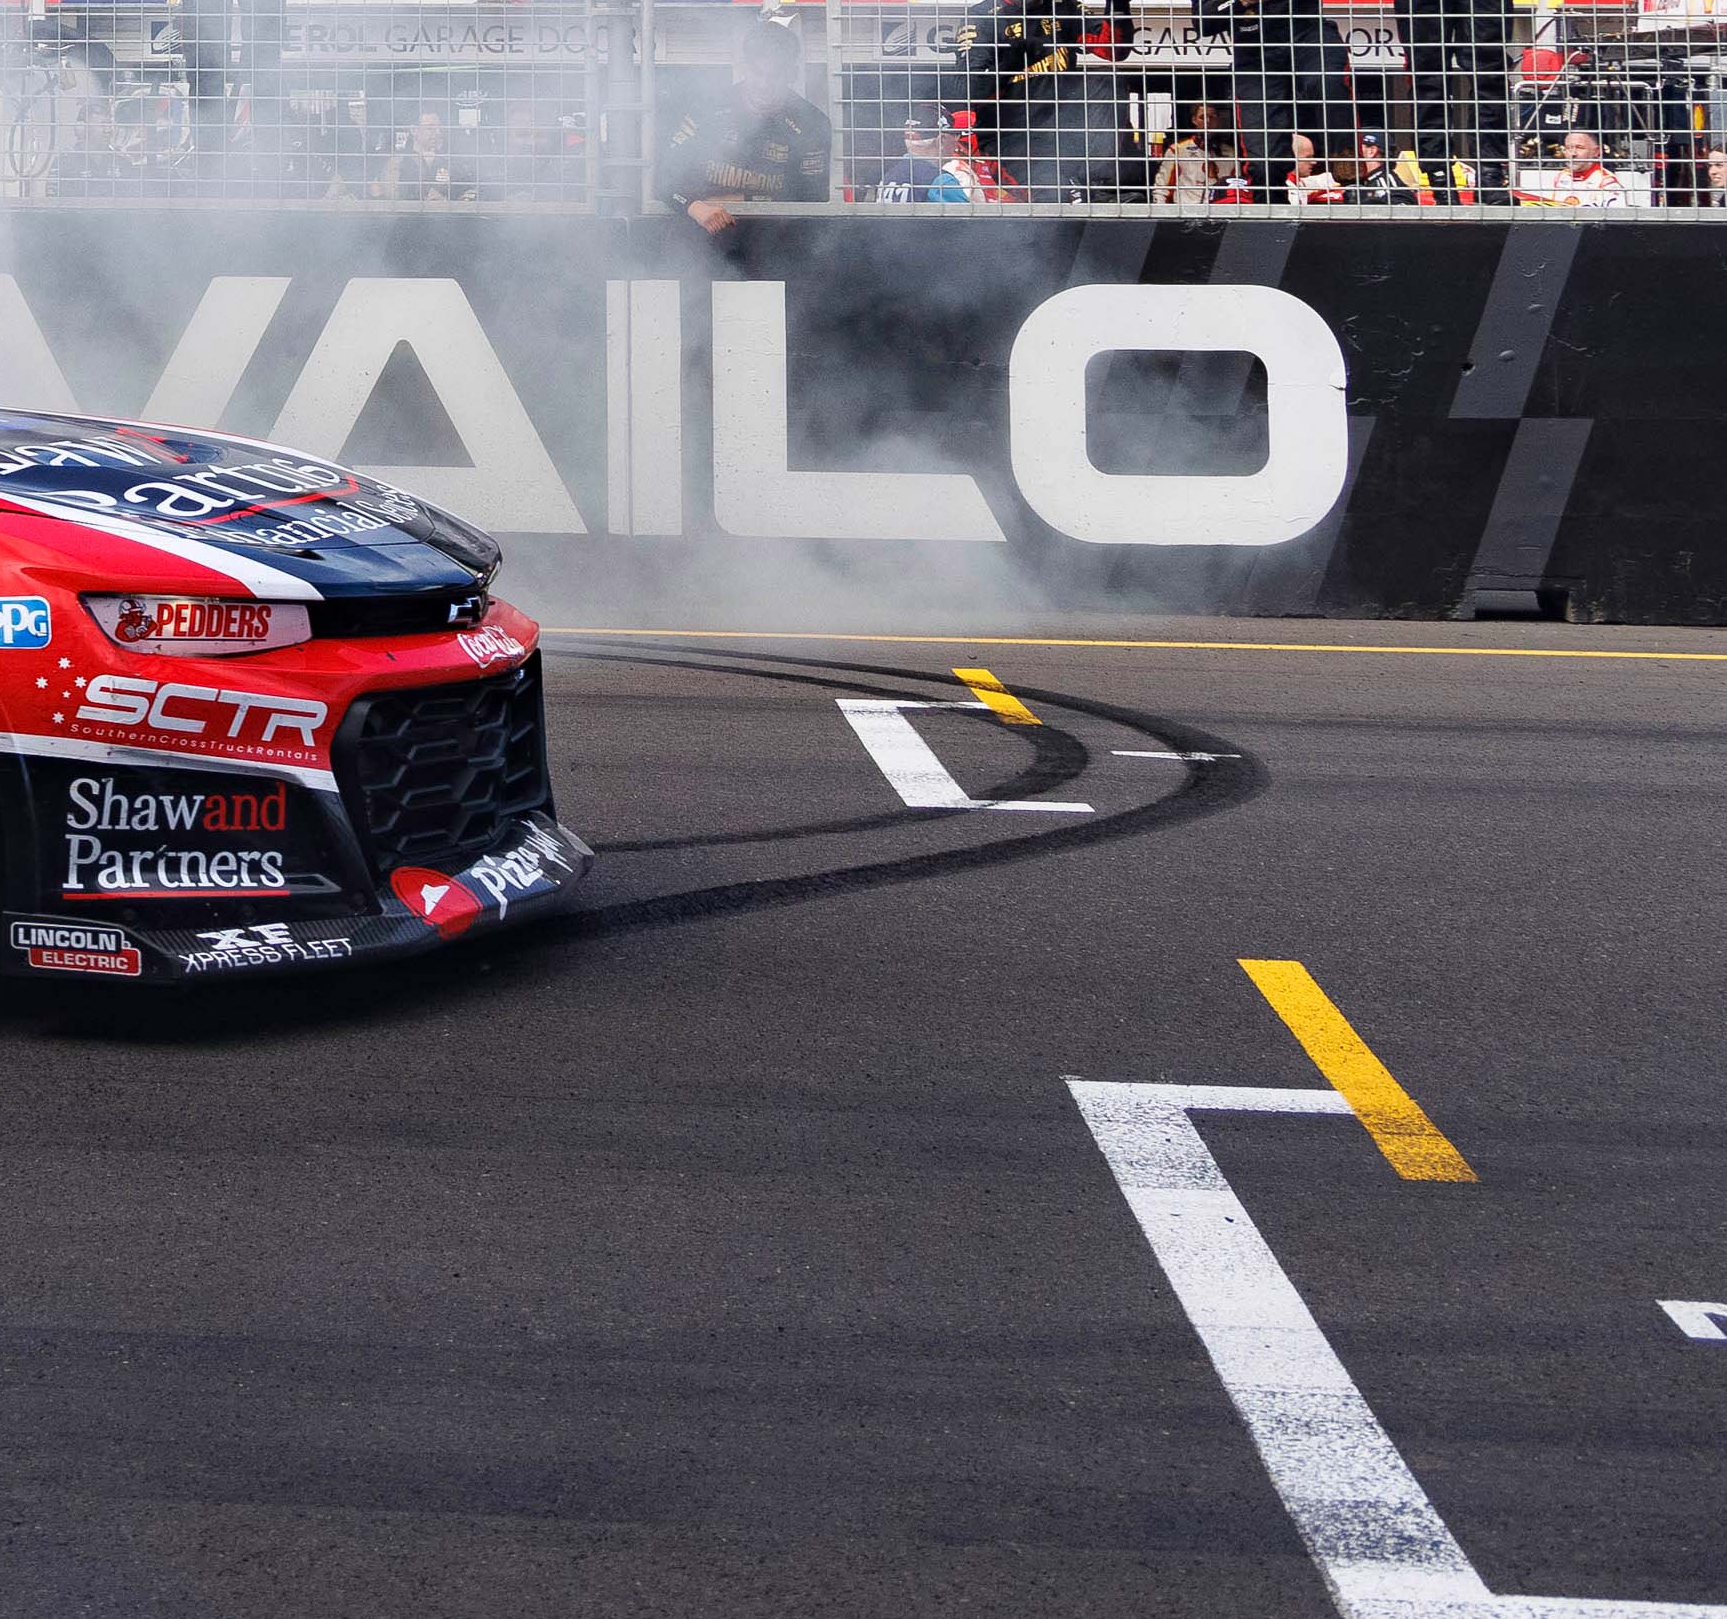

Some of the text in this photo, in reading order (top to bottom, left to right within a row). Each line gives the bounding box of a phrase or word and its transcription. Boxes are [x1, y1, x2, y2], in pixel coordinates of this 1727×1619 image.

[385, 25, 524, 55] GARAGE
[1132, 26, 1234, 57] GARA
[155, 602, 272, 639] PEDDERS
[75, 674, 328, 747] SCTR
[63, 834, 286, 890] Partners
[18, 928, 118, 952] LINCOLN
[180, 937, 353, 972] XPRESS FLEET
[41, 950, 130, 970] ELECTRIC
